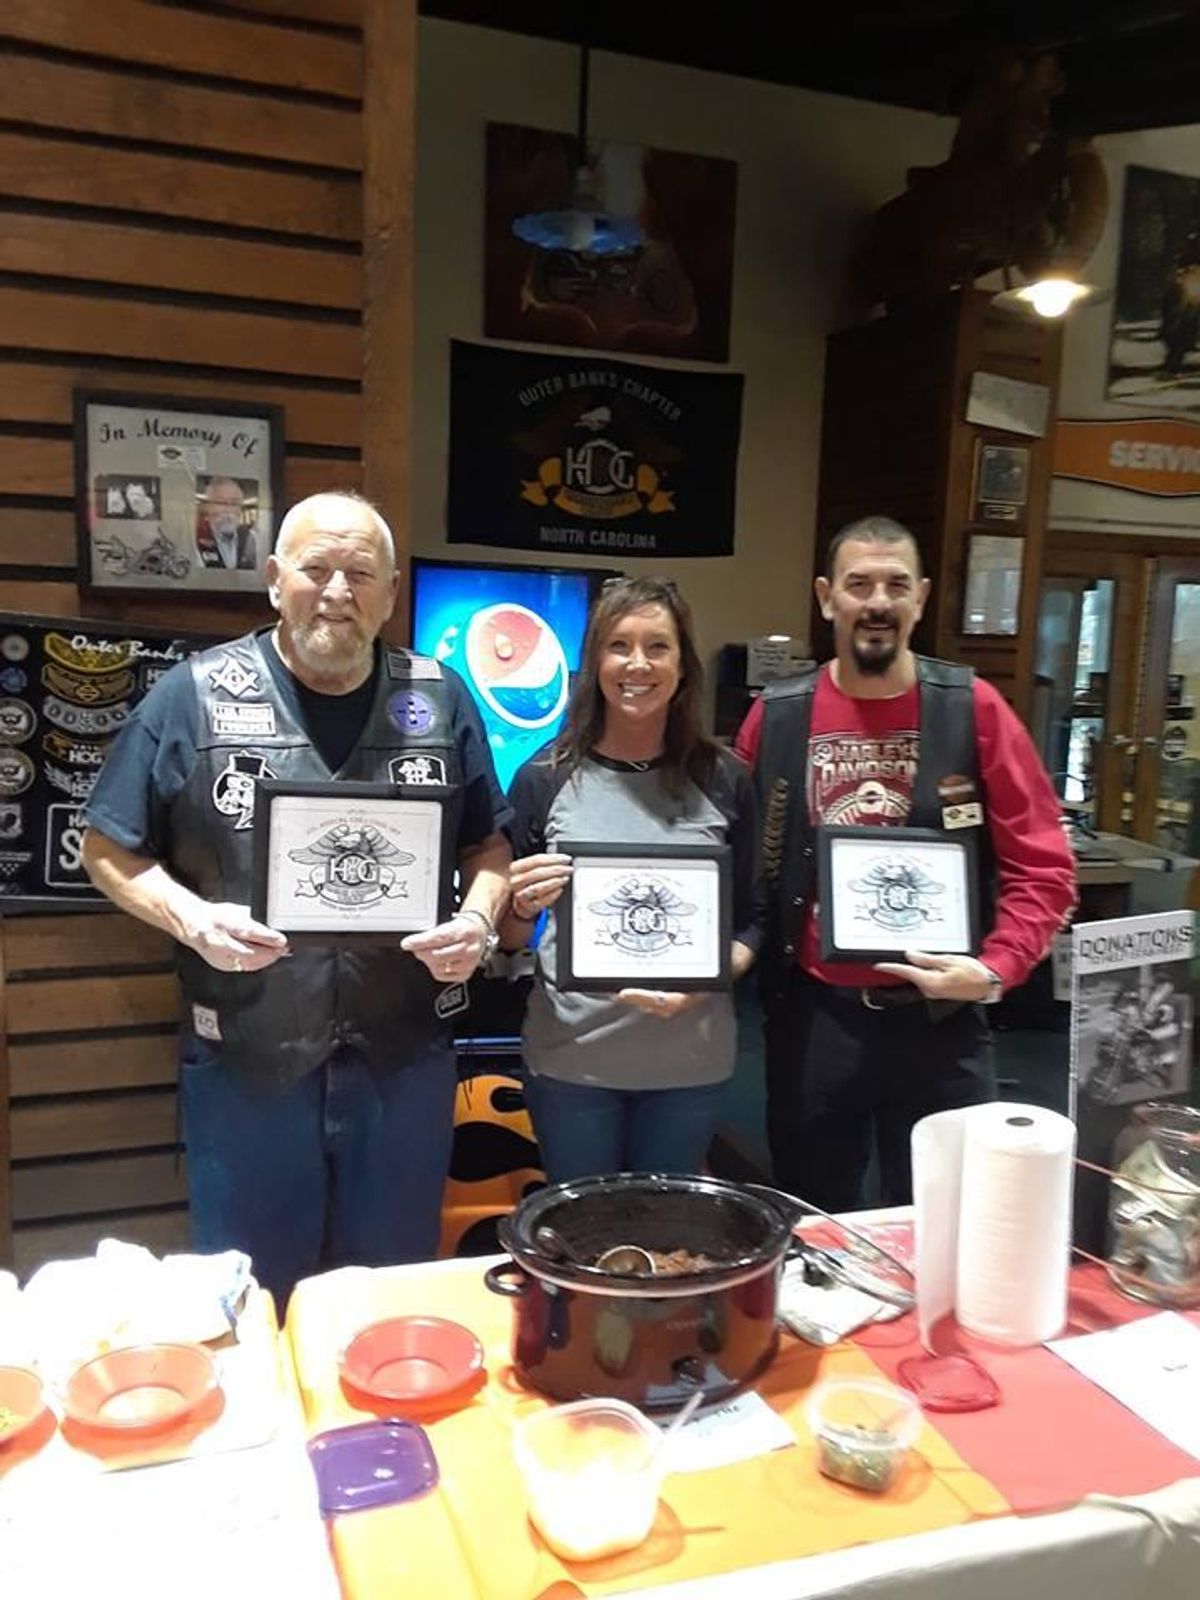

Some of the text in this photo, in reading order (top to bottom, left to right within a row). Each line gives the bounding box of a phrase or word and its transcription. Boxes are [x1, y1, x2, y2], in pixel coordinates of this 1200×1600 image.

[518, 371, 683, 422] OUTER BANKS CHAPTER
[100, 422, 126, 443] In
[137, 418, 222, 448] Memory
[539, 526, 657, 549] NORTH CAROLINA
[71, 634, 185, 662] Outer Banks
